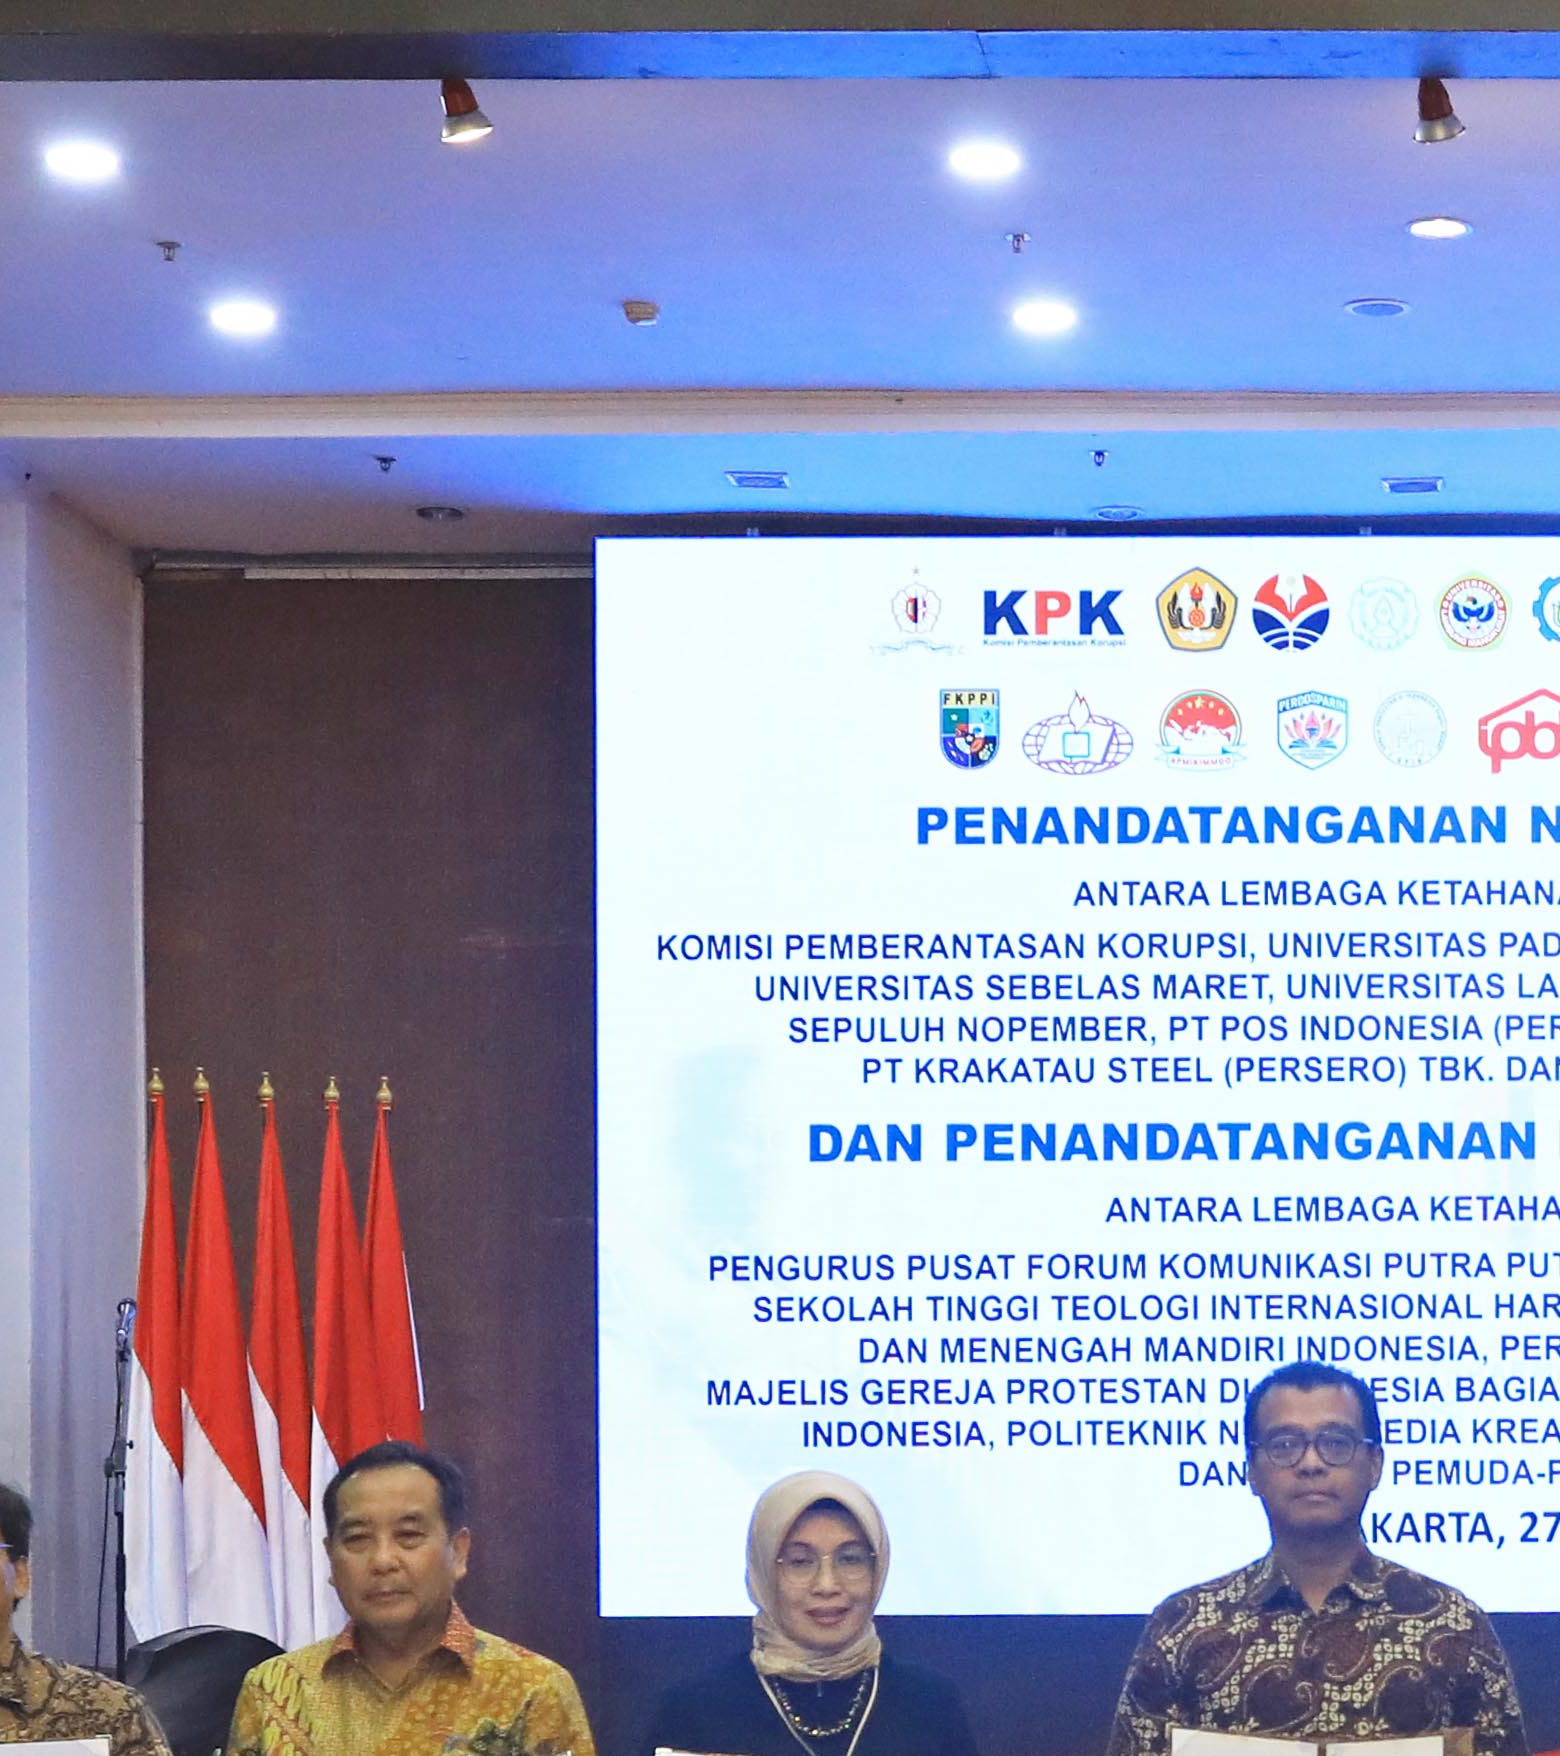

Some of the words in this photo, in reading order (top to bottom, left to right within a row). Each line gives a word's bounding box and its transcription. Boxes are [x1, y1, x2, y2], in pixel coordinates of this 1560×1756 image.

[983, 590, 1125, 636] KPK
[943, 692, 996, 705] FKPPI
[918, 805, 1506, 845] PENANDATANGANAN
[1074, 881, 1210, 906] ANTARA
[1222, 880, 1387, 906] LEMBAGA
[658, 934, 772, 960] KOMISI
[786, 933, 1084, 960] PEMBERANTASAN
[1098, 932, 1255, 962] KORUPSI,
[1269, 932, 1486, 958] UNIVERSITAS
[756, 975, 973, 1001] UNIVERSITAS
[986, 974, 1140, 1000] SEBELAS
[1153, 974, 1273, 1003] MARET,
[1287, 973, 1504, 999] UNIVERSITAS
[789, 1017, 943, 1043] SEPULUH
[958, 1016, 1156, 1045] NOPEMBER,
[1170, 1016, 1209, 1041] PT
[1222, 1015, 1288, 1041] POS
[1301, 1015, 1483, 1041] INDONESIA
[863, 1058, 903, 1083] PT
[915, 1057, 1094, 1083] KRAKATAU
[1108, 1057, 1212, 1083] STEEL
[1225, 1056, 1406, 1088] (PERSERO)
[1419, 1056, 1493, 1082] TBK.
[809, 1124, 921, 1162] DAN
[946, 1121, 1535, 1161] PENANDATANGANAN
[1105, 1197, 1242, 1222] ANTARA
[1254, 1196, 1419, 1222] LEMBAGA
[710, 1254, 894, 1281] PENGURUS
[908, 1254, 1015, 1280] PUSAT
[1028, 1253, 1146, 1280] FORUM
[1160, 1252, 1370, 1279] KOMUNIKASI
[1385, 1253, 1496, 1278] PUTRA
[754, 1296, 912, 1322] SEKOLAH
[926, 1295, 1038, 1321] TINGGI
[1051, 1295, 1198, 1321] TEOLOGI
[1212, 1293, 1482, 1320] INTERNASIONAL
[859, 1338, 927, 1363] DAN
[941, 1337, 1131, 1363] MENENGAH
[1145, 1336, 1283, 1362] MANDIRI
[1297, 1335, 1487, 1365] INDONESIA,
[707, 1379, 848, 1405] MAJELIS
[861, 1379, 995, 1405] GEREJA
[1007, 1378, 1205, 1404] PROTESTAN
[803, 1421, 994, 1450] INDONESIA,
[1008, 1420, 1207, 1446] POLITEKNIK
[1385, 1419, 1461, 1444] EDIA
[1180, 1460, 1247, 1486] DAN
